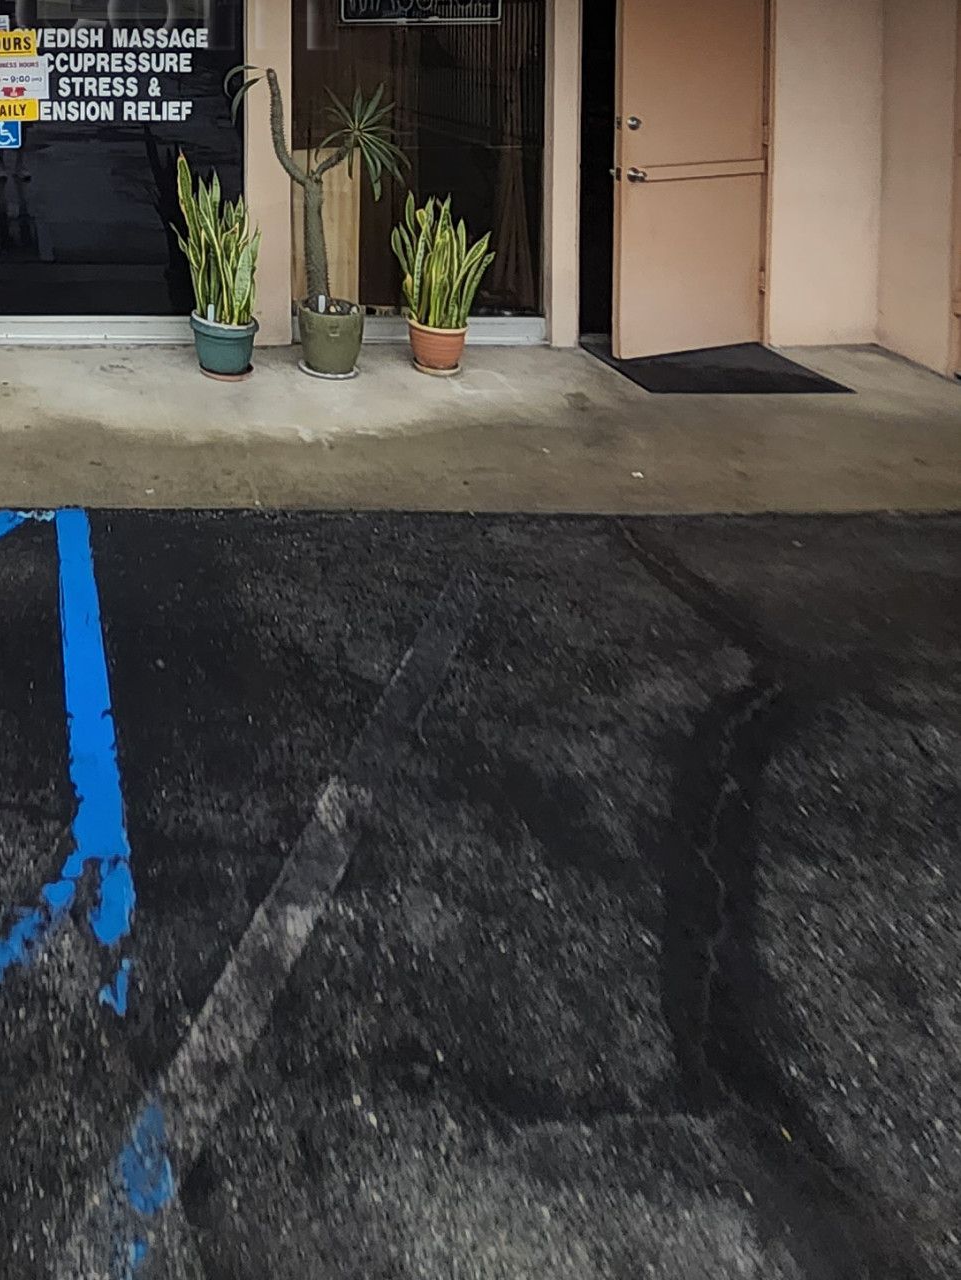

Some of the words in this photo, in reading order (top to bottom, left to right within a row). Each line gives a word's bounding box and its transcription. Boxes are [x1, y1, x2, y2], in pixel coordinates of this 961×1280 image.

[36, 28, 103, 48] EDISH
[112, 28, 209, 48] MASSAGE
[42, 52, 192, 73] CCUPRESSURE
[58, 76, 139, 97] STRESS
[147, 77, 161, 97] &
[39, 101, 114, 121] ENSION
[123, 101, 193, 121] RELIEF
